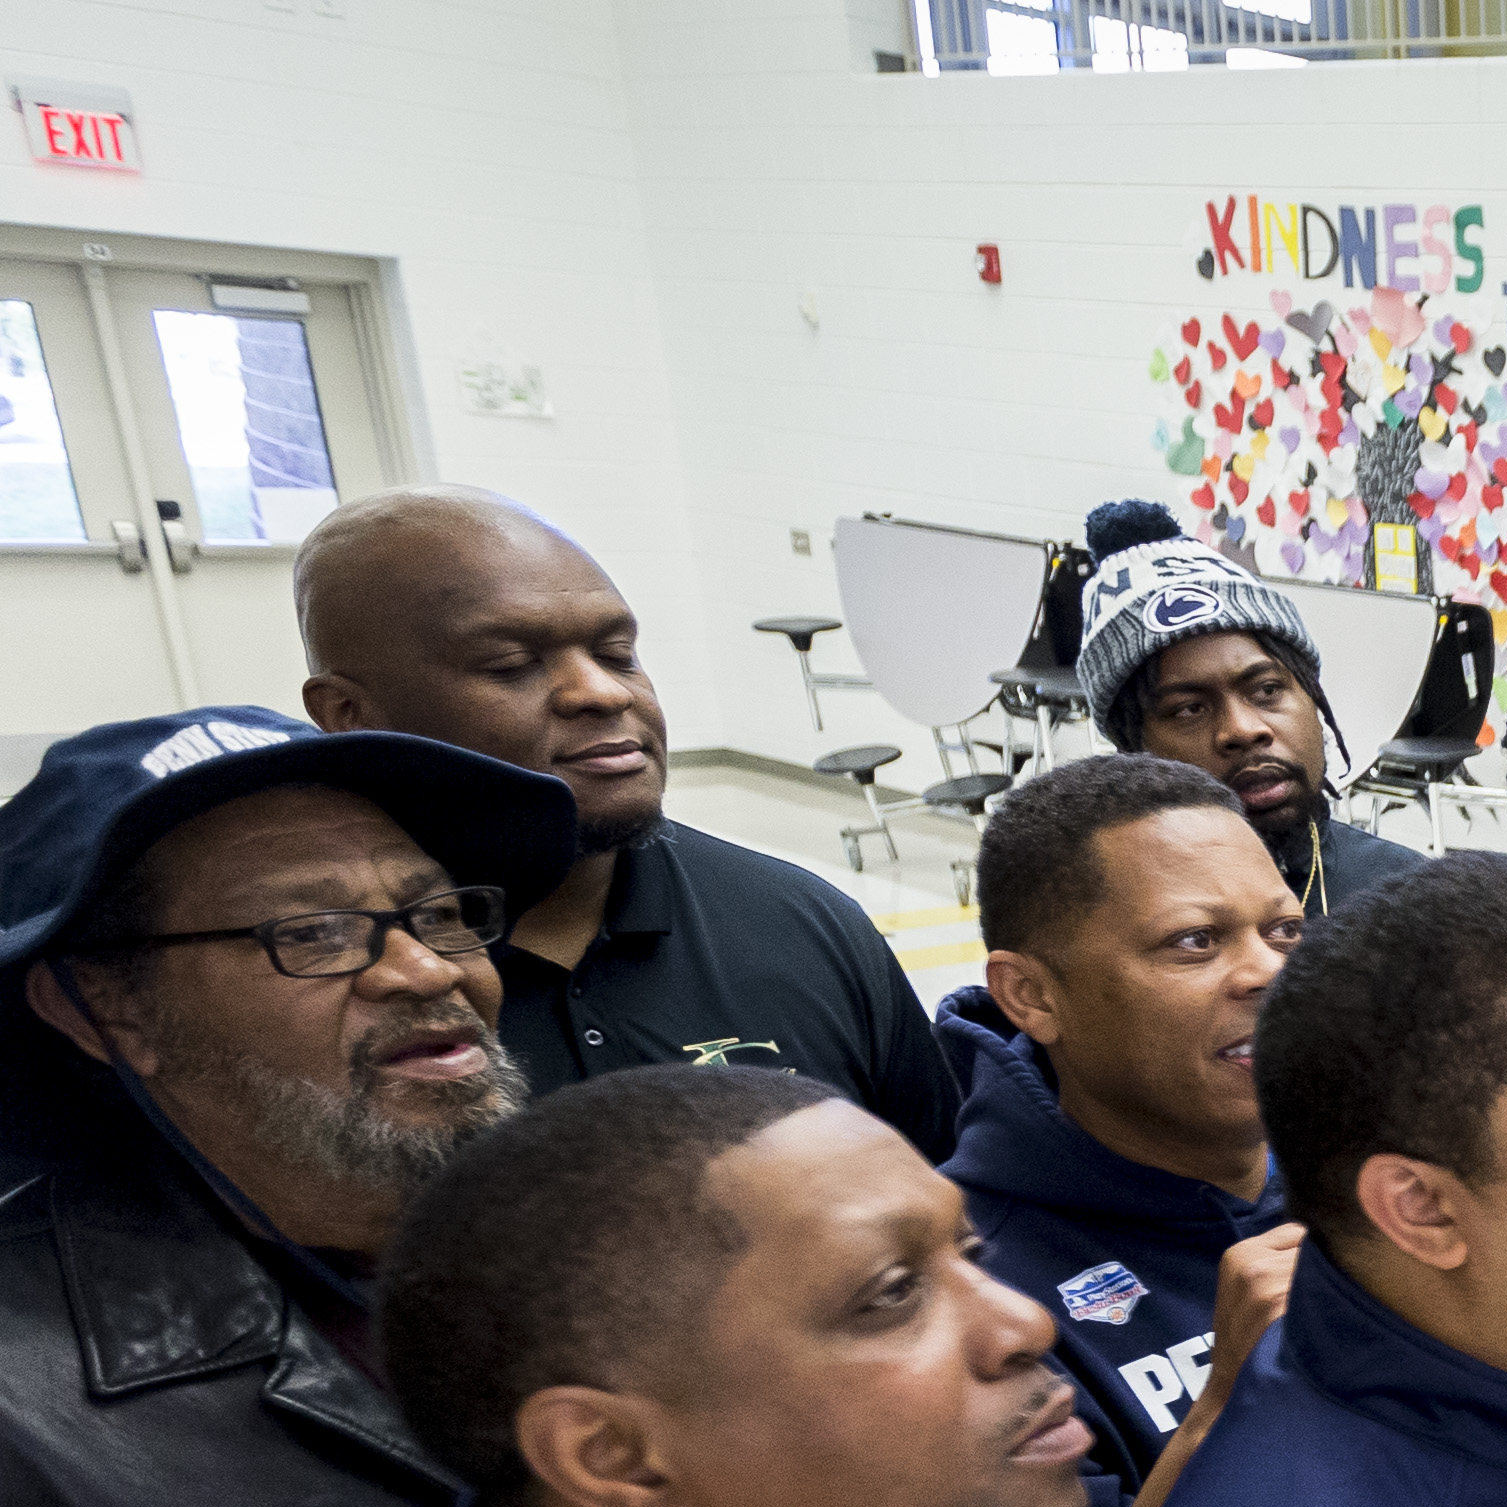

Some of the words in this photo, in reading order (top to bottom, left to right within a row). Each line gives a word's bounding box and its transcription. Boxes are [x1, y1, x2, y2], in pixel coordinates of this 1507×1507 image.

[41, 108, 124, 161] EXIT
[1205, 194, 1485, 294] KINDNESS
[1117, 1332, 1215, 1433] PE
